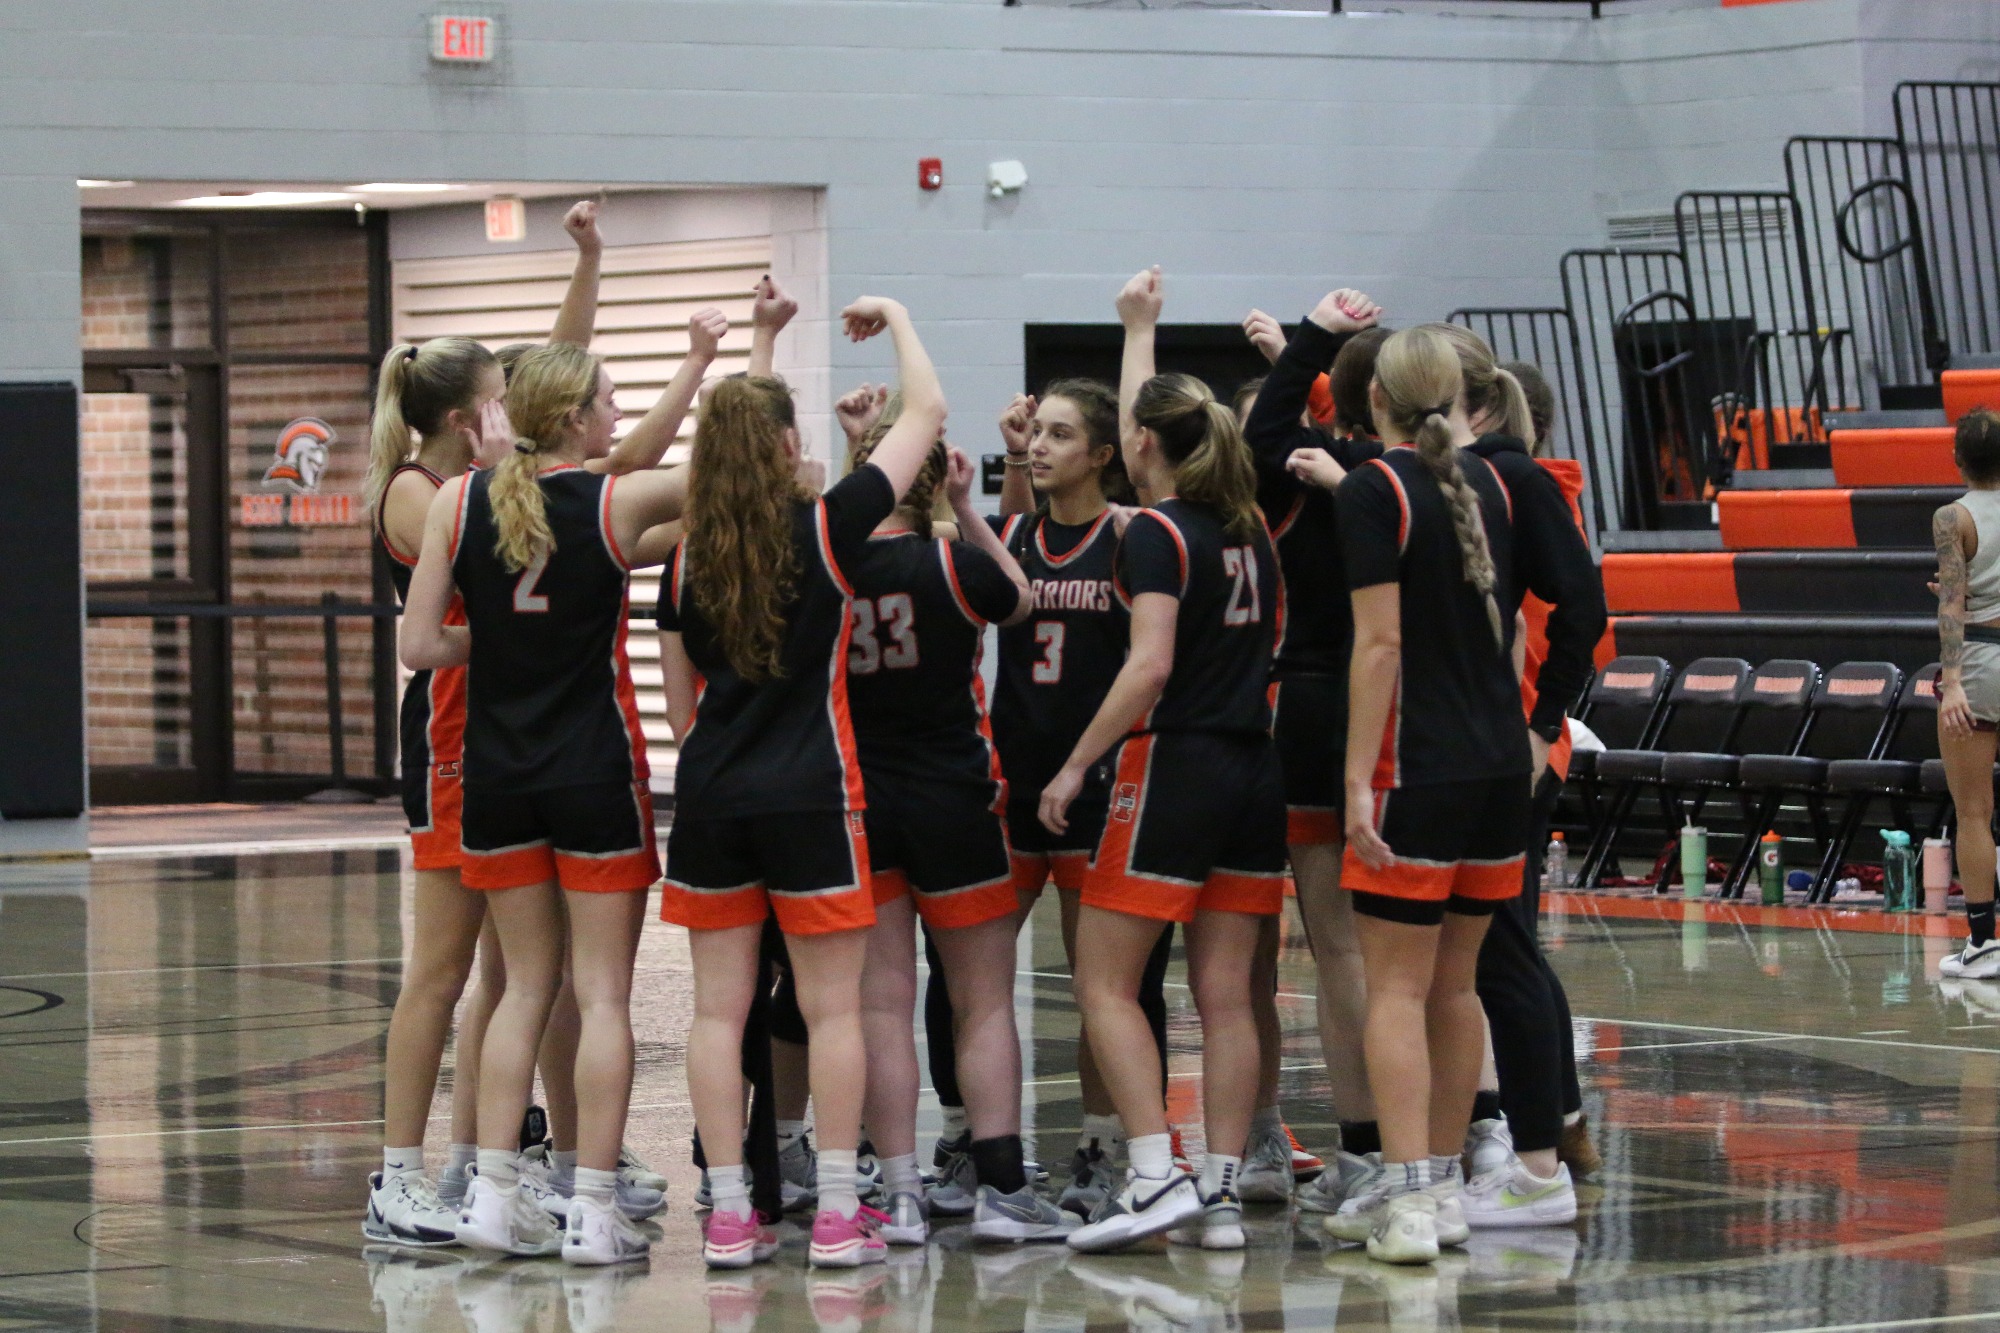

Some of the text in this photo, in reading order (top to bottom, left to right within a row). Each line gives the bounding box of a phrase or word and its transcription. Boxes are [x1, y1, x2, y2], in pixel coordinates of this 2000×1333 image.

[443, 18, 487, 57] EXIT
[513, 540, 549, 612] 2
[1030, 579, 1112, 611] RRIORS
[1222, 544, 1261, 627] 21
[847, 592, 919, 673] 33
[1032, 620, 1065, 684] 3
